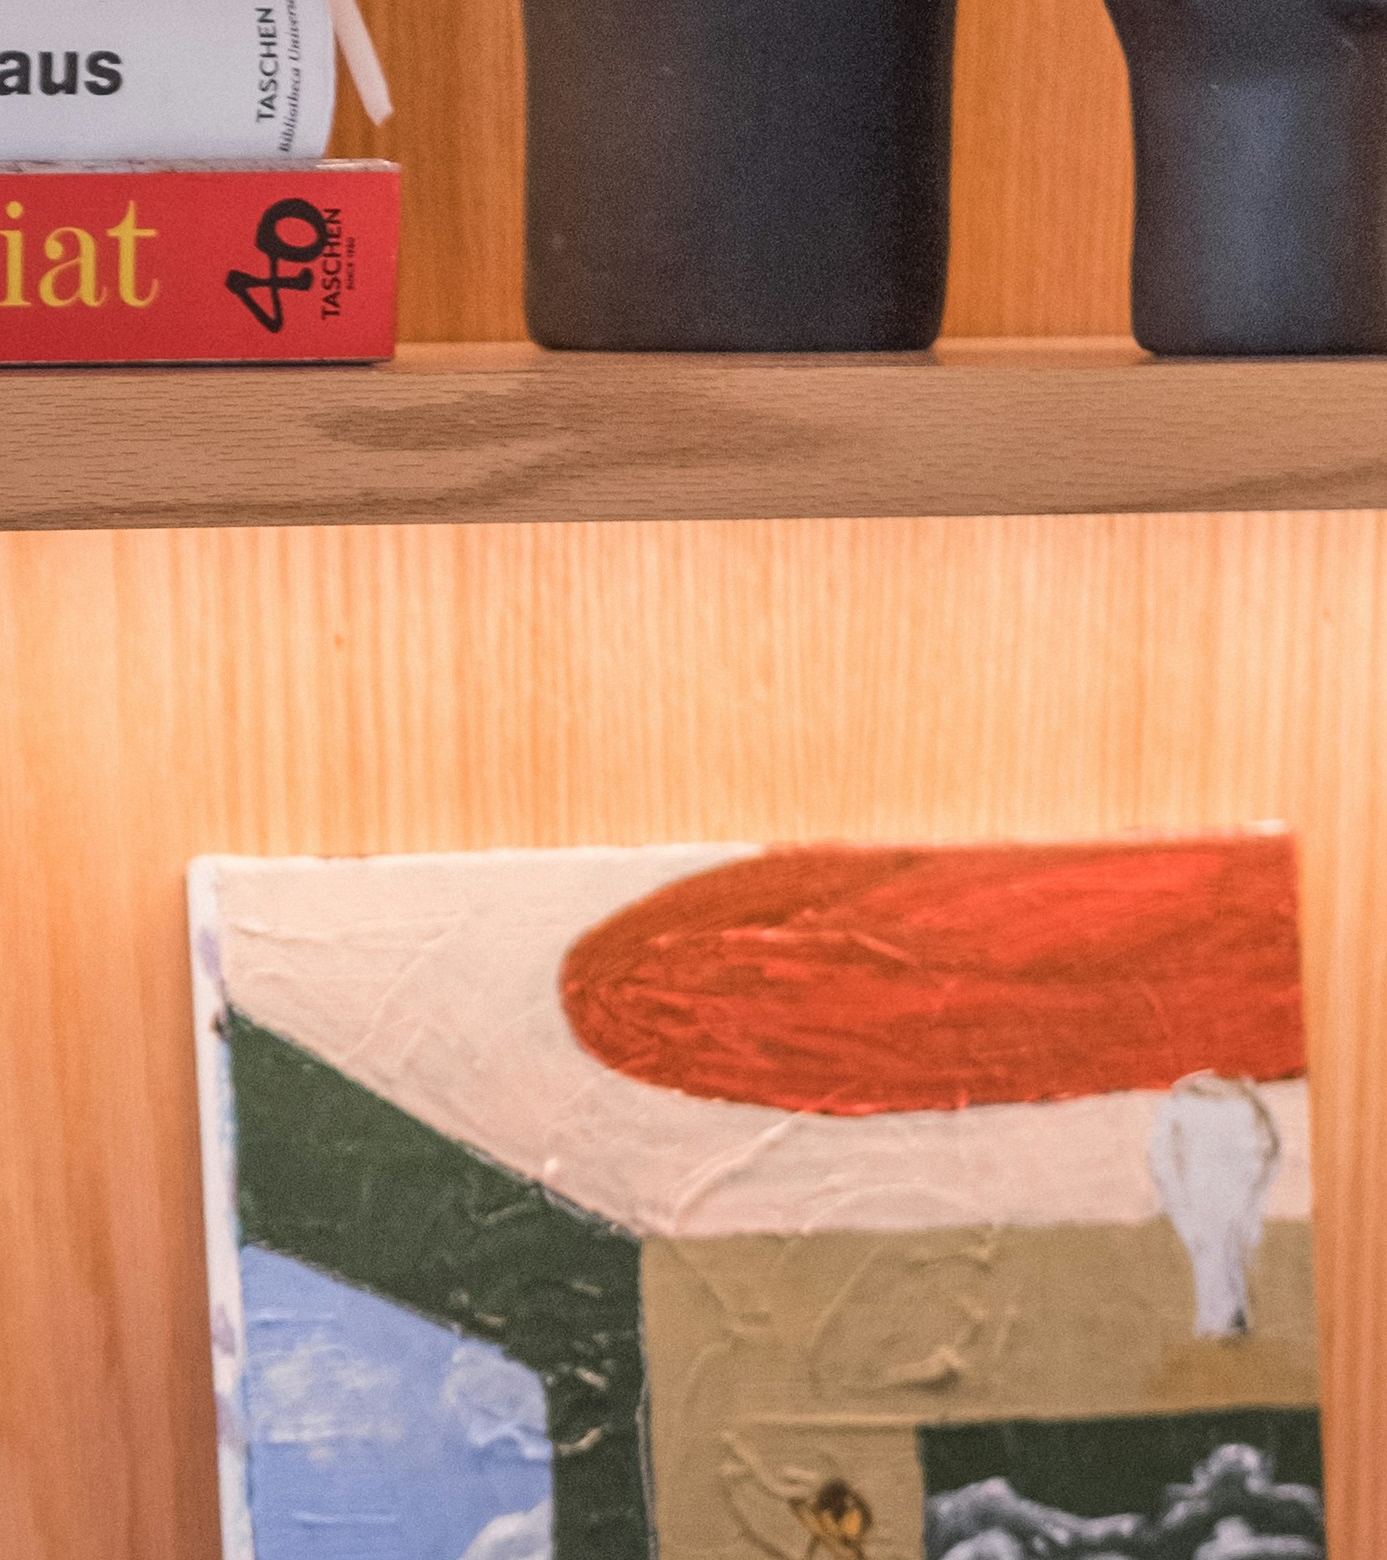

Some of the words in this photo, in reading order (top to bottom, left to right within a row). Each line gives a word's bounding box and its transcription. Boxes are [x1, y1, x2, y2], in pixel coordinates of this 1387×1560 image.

[255, 7, 278, 123] TASCHEN
[277, 67, 302, 154] Bibliotheca
[224, 197, 329, 333] 40
[321, 208, 342, 320] TASCHEN
